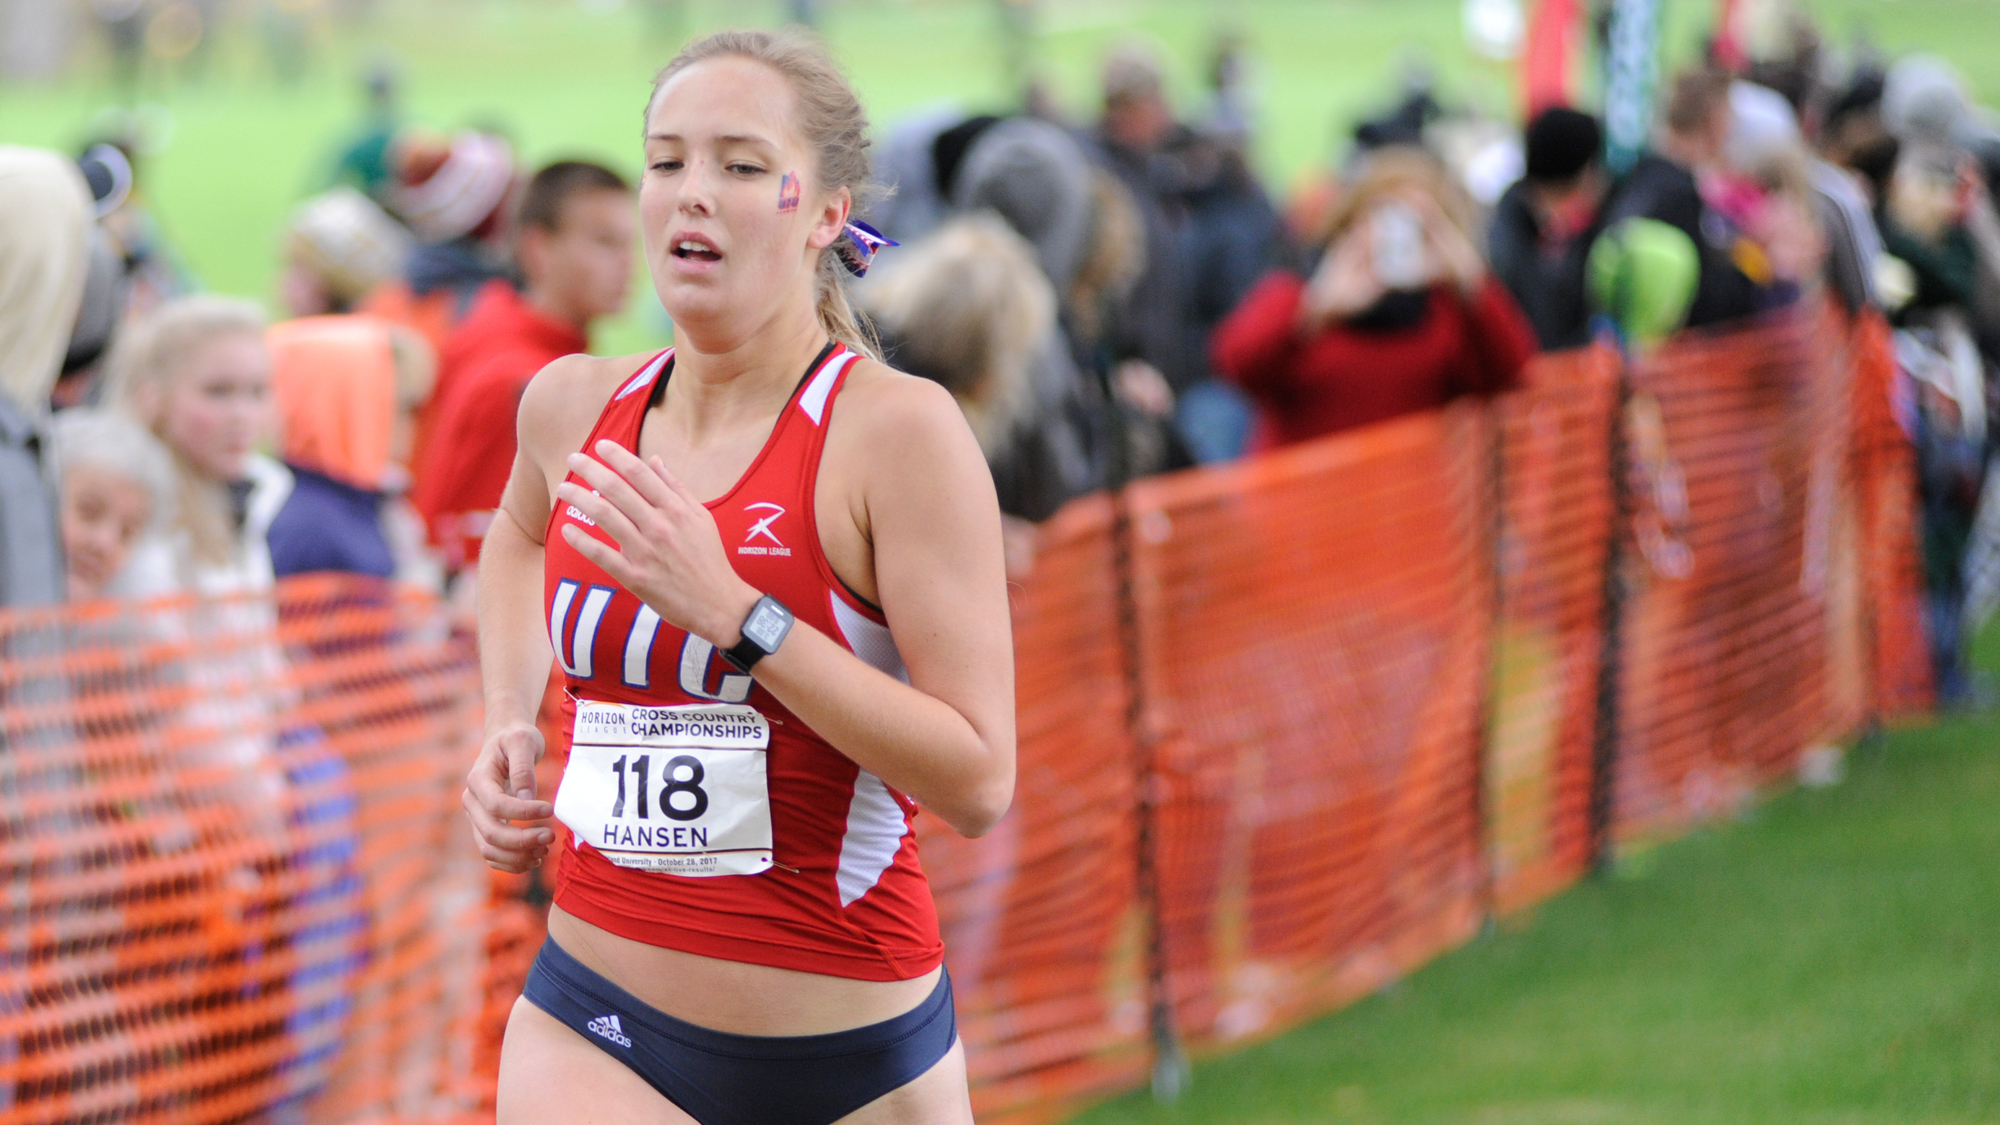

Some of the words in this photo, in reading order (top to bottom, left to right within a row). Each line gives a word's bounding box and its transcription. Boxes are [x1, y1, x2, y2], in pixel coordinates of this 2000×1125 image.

[737, 546, 768, 555] HORIZON
[769, 546, 792, 557] LEAGUE
[581, 712, 625, 725] HORIZON
[631, 708, 679, 721] CROSS
[682, 714, 756, 724] COUNTRY
[580, 726, 627, 734] LEAGUE
[631, 722, 762, 739] CHAMPIONSHIPS
[612, 755, 709, 821] 118
[603, 823, 708, 848] HANSEN
[621, 856, 652, 866] University
[657, 858, 684, 866] October
[686, 858, 698, 867] 28,
[700, 857, 718, 865] 2017
[587, 1020, 632, 1048] adidas
